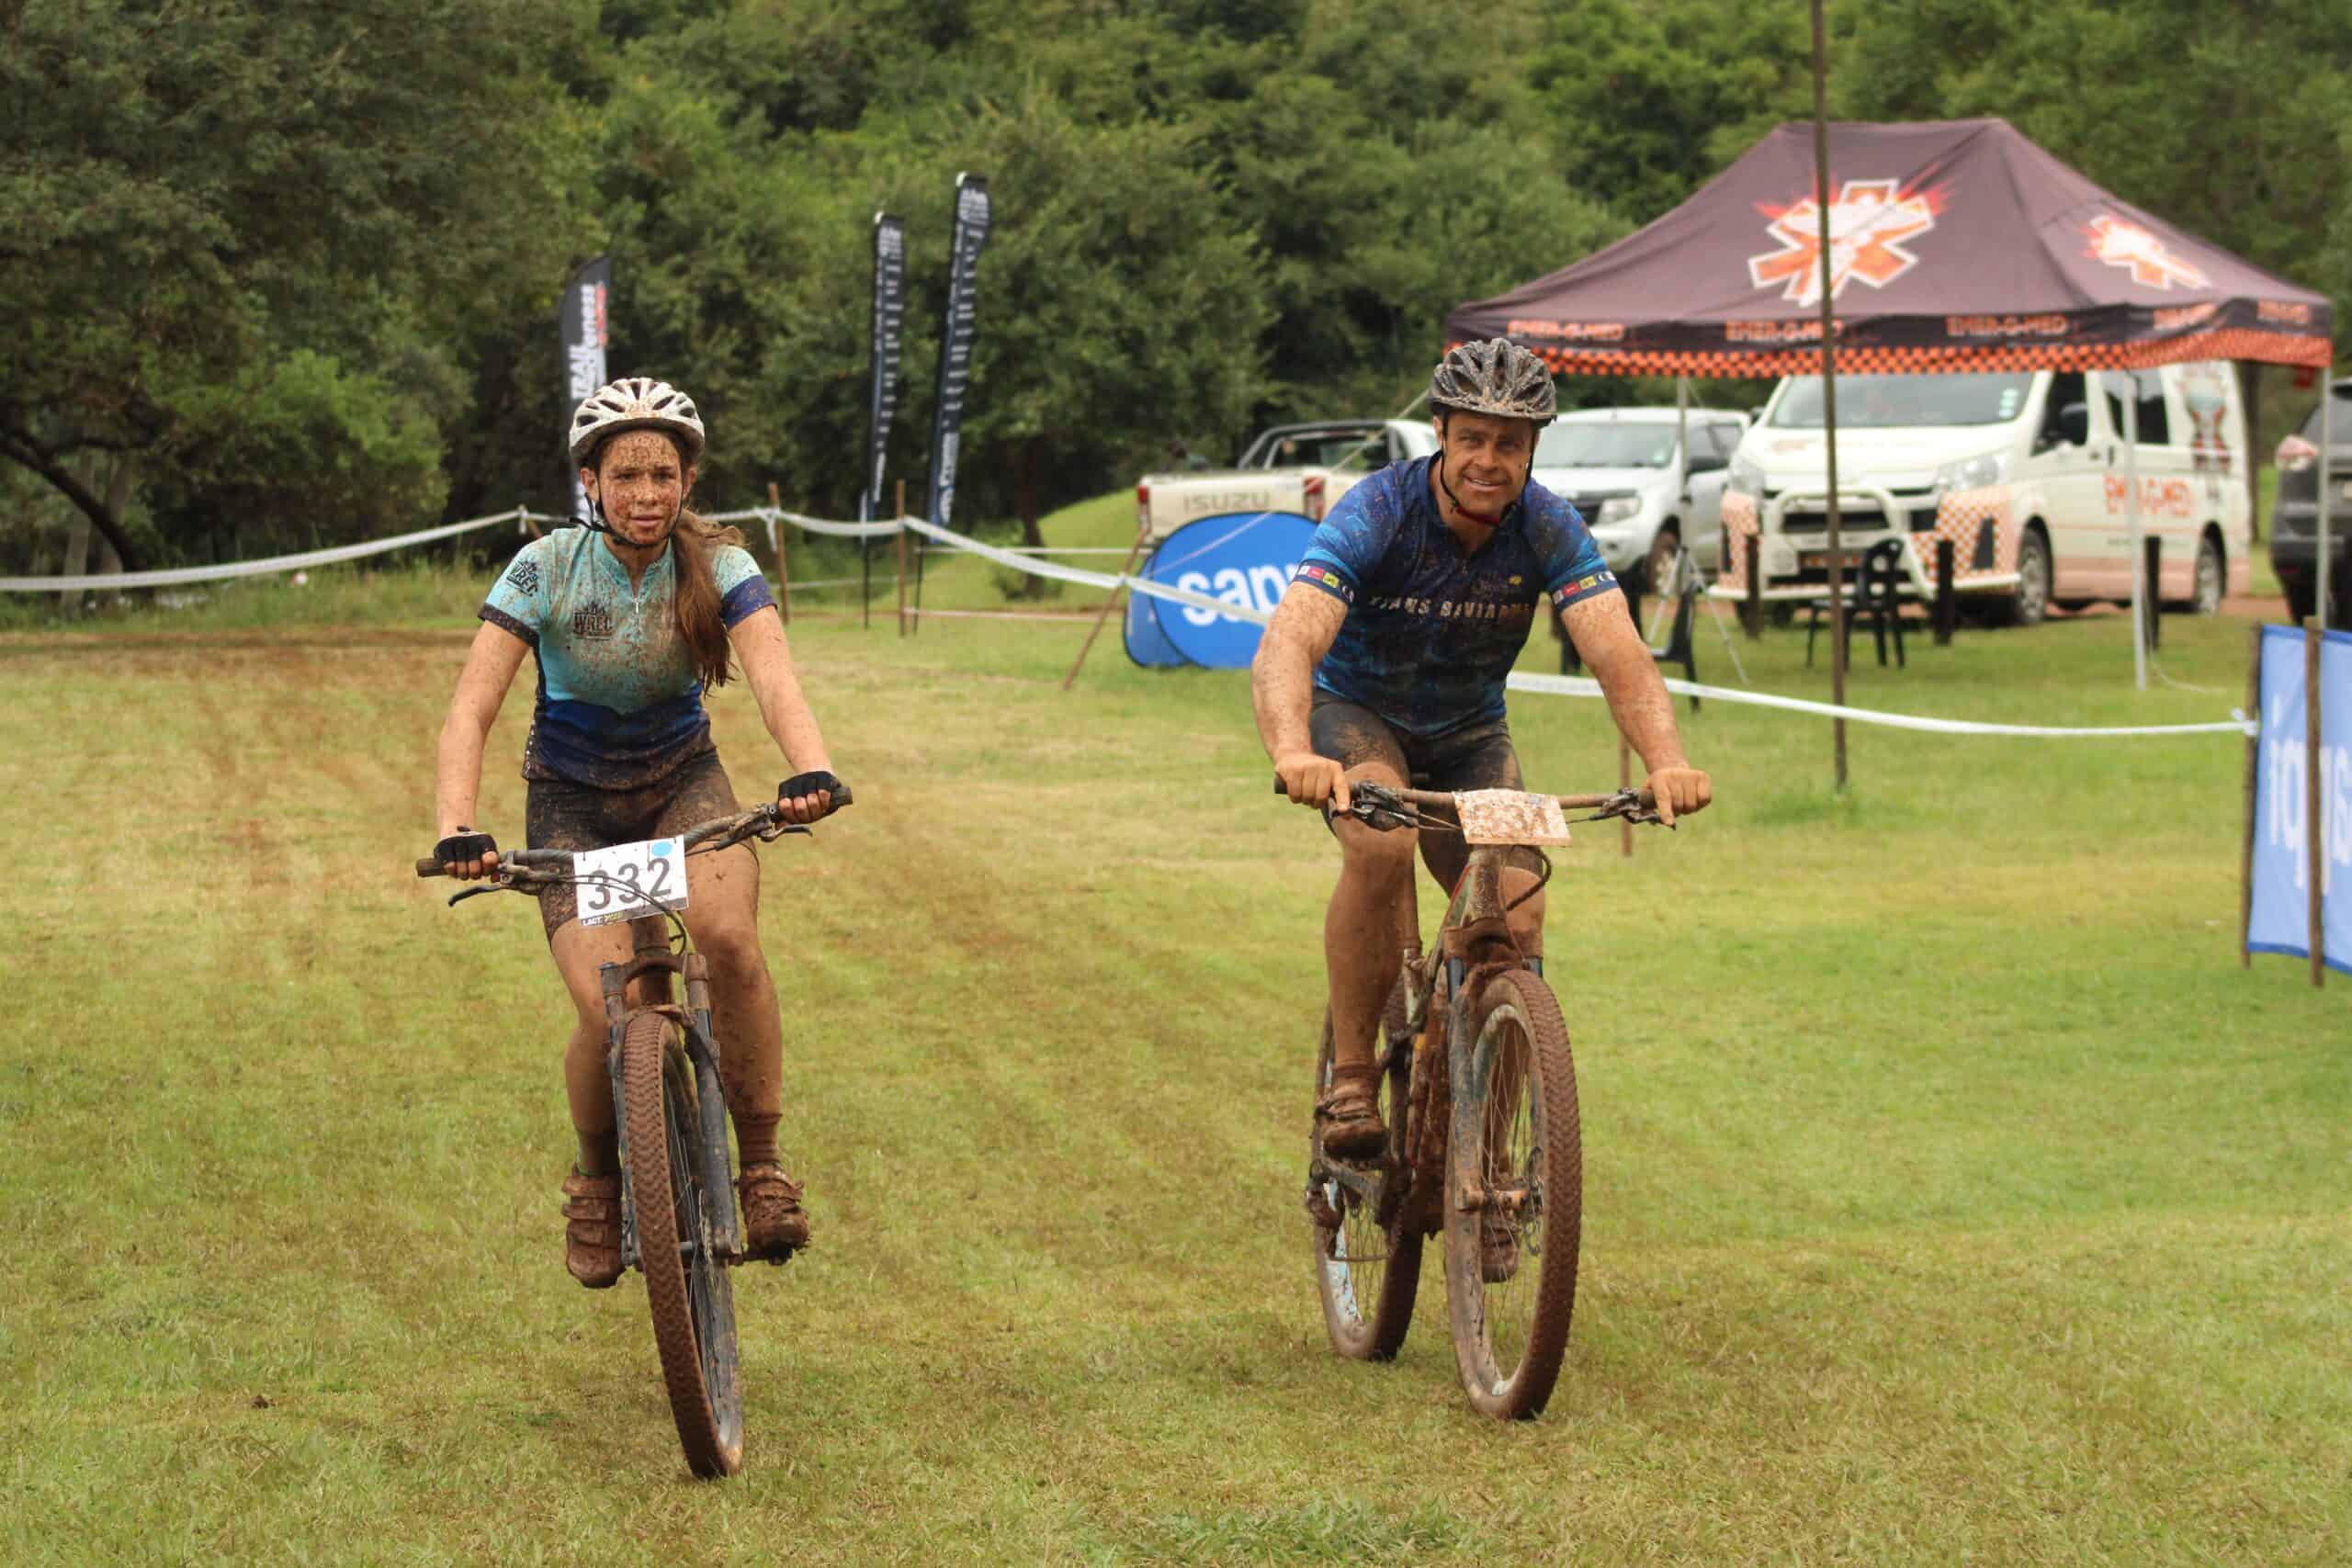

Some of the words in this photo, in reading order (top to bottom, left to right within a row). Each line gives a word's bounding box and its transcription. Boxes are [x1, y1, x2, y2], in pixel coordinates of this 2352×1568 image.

[1725, 320, 1844, 342] EMER-G-MD
[1182, 491, 1271, 513] ISUZU
[1177, 563, 1299, 627] sap
[587, 857, 672, 910] 332
